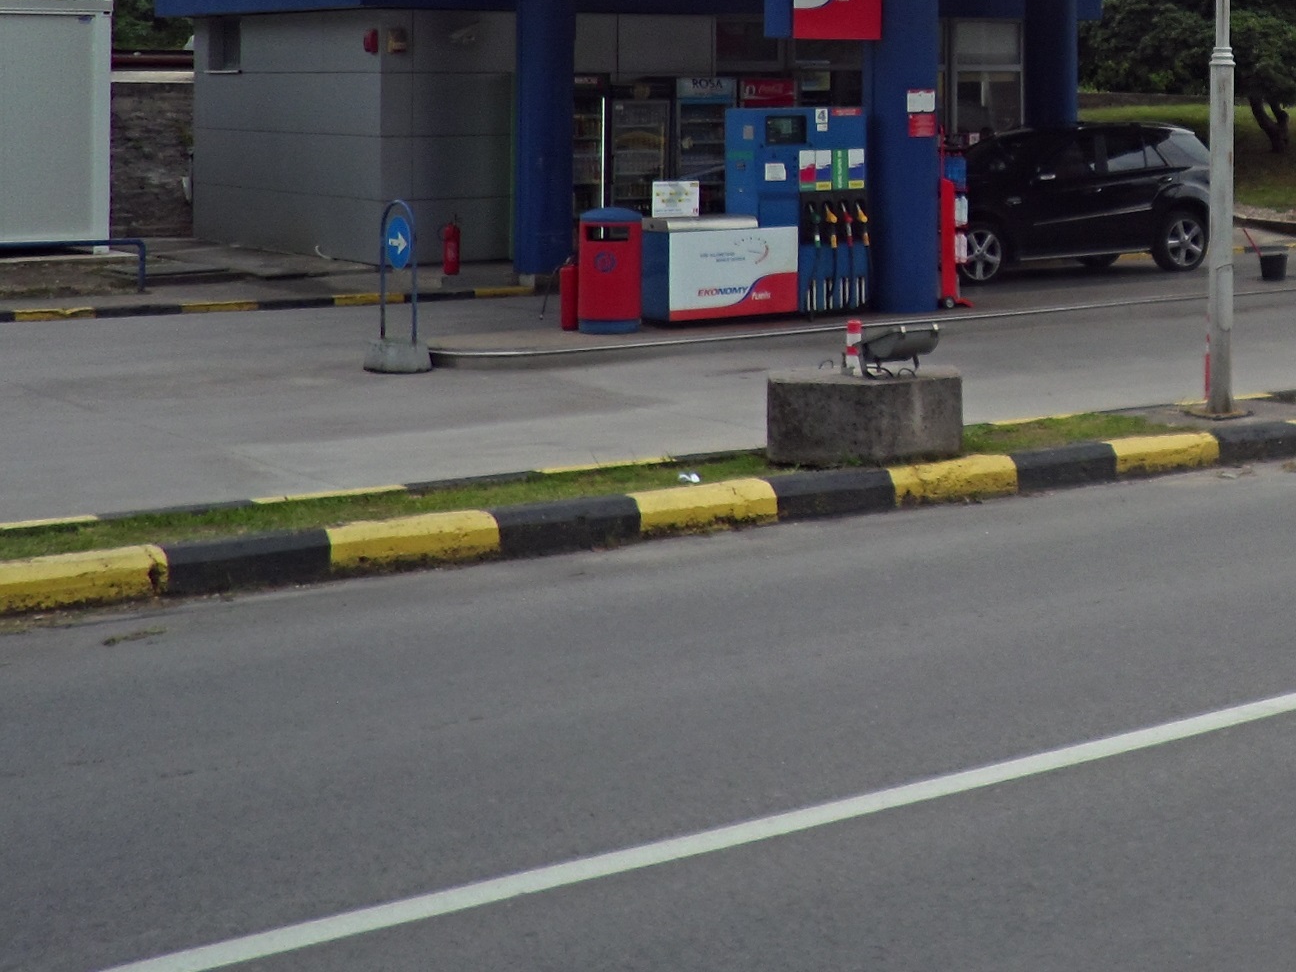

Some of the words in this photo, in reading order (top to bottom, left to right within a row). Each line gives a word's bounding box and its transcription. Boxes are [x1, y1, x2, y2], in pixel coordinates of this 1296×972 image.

[692, 78, 722, 89] ROSA
[817, 109, 827, 121] 4
[698, 286, 748, 297] EKONOMY
[752, 291, 771, 300] fuels
